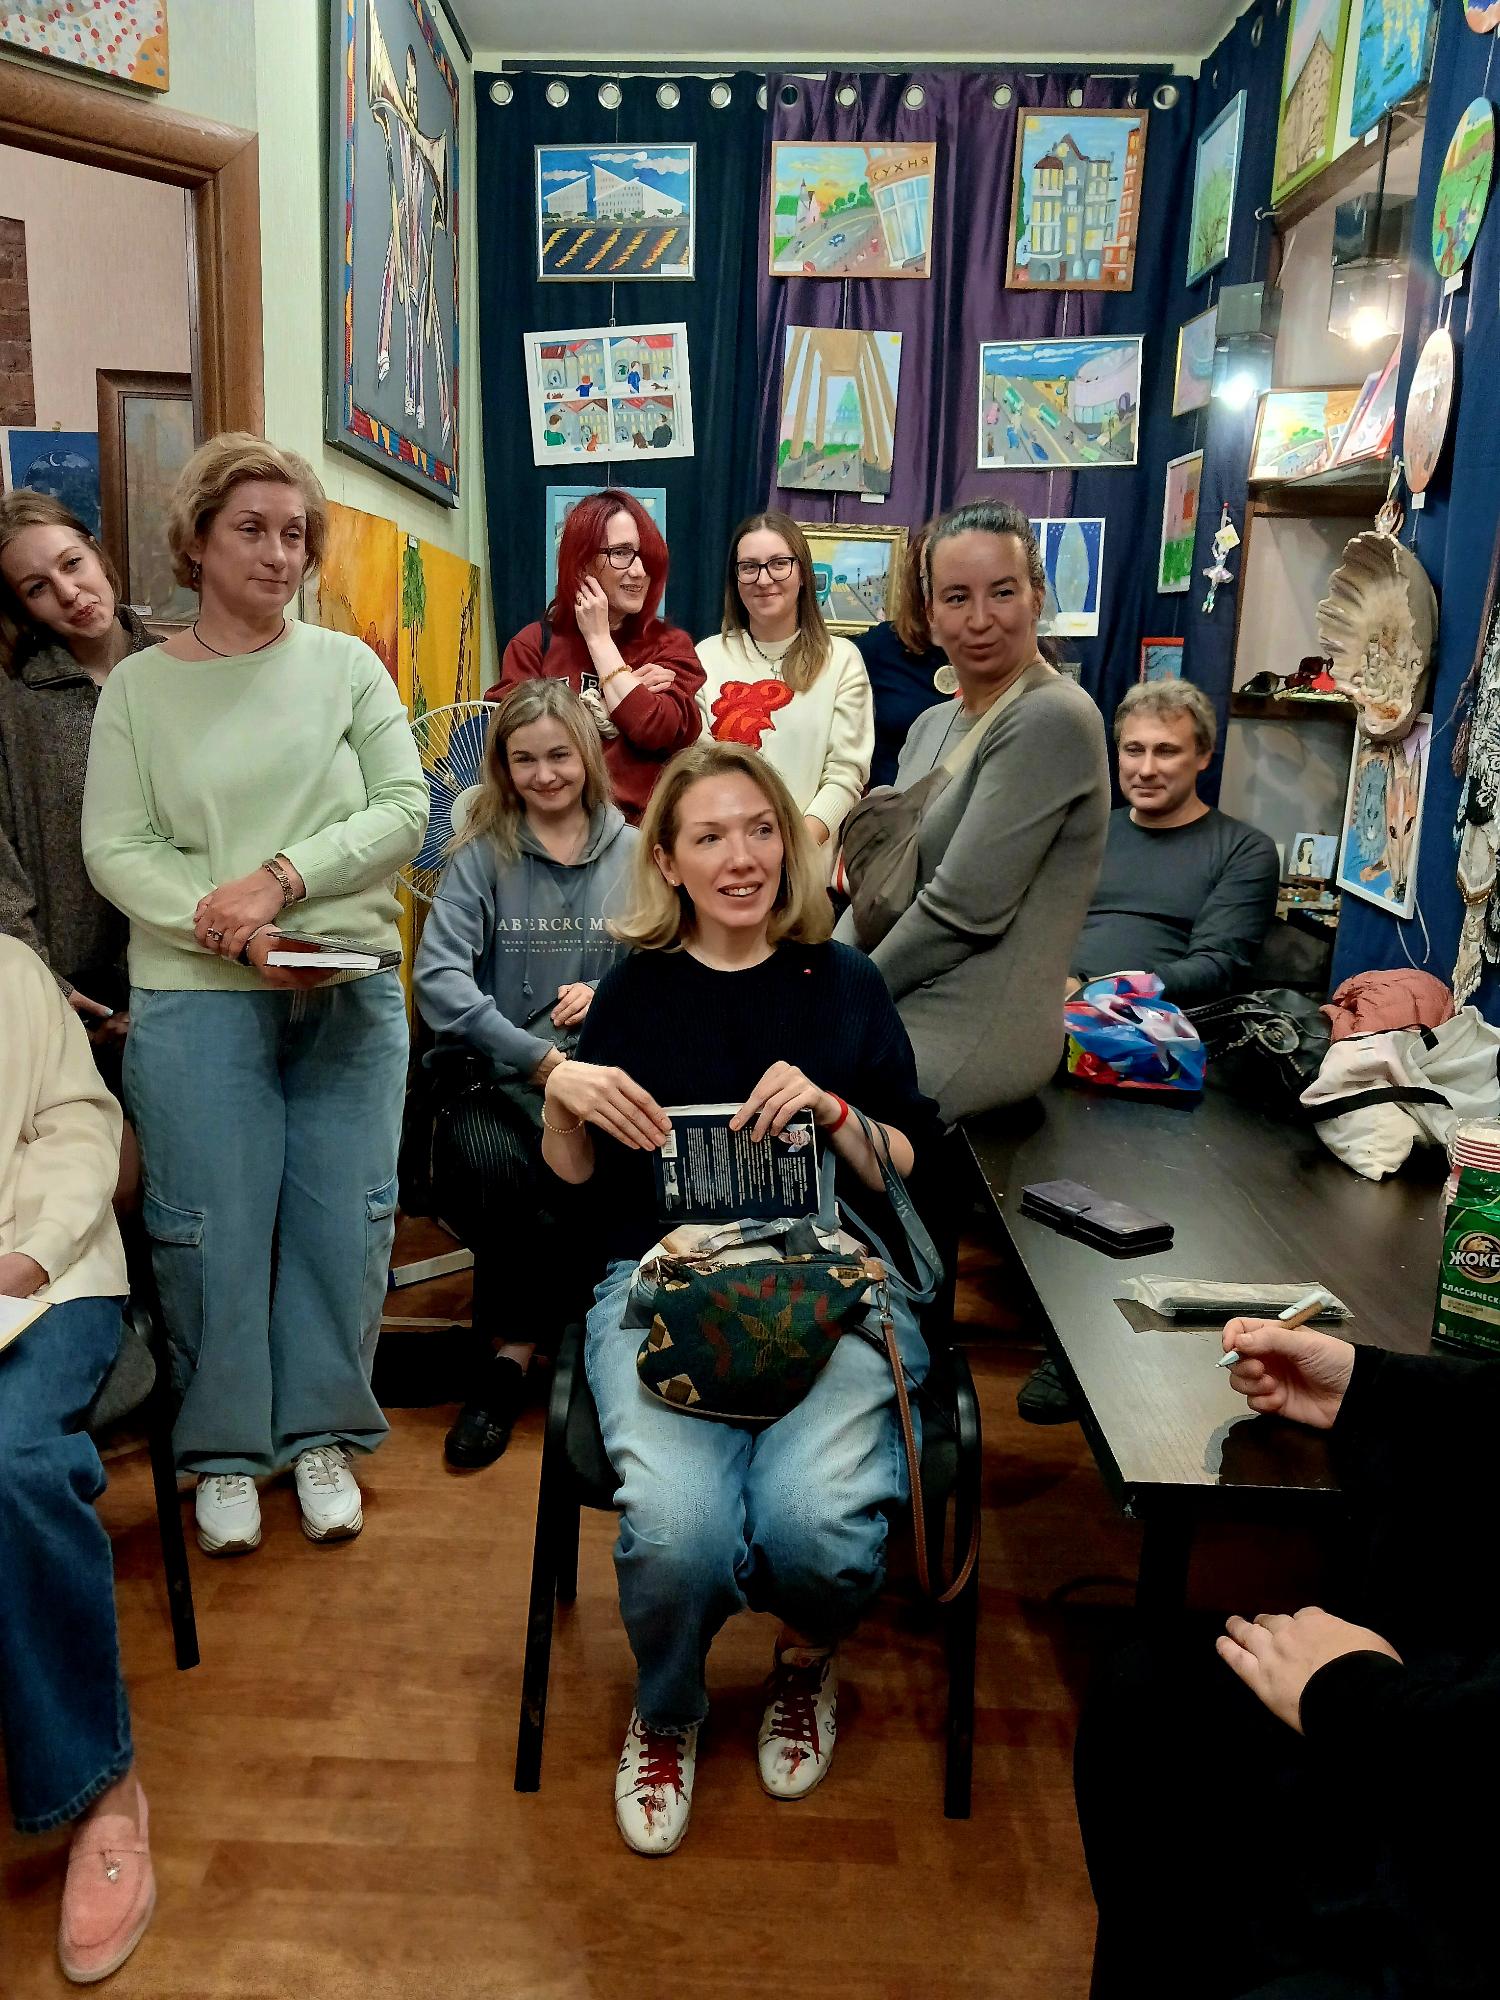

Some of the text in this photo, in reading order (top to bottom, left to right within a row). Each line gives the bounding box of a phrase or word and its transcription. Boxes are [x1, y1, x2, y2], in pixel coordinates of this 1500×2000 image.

[873, 156, 929, 181] СУХНЯ
[497, 917, 614, 931] ABERCROM
[1442, 1282, 1500, 1304] КЛАССИЧЕСК
